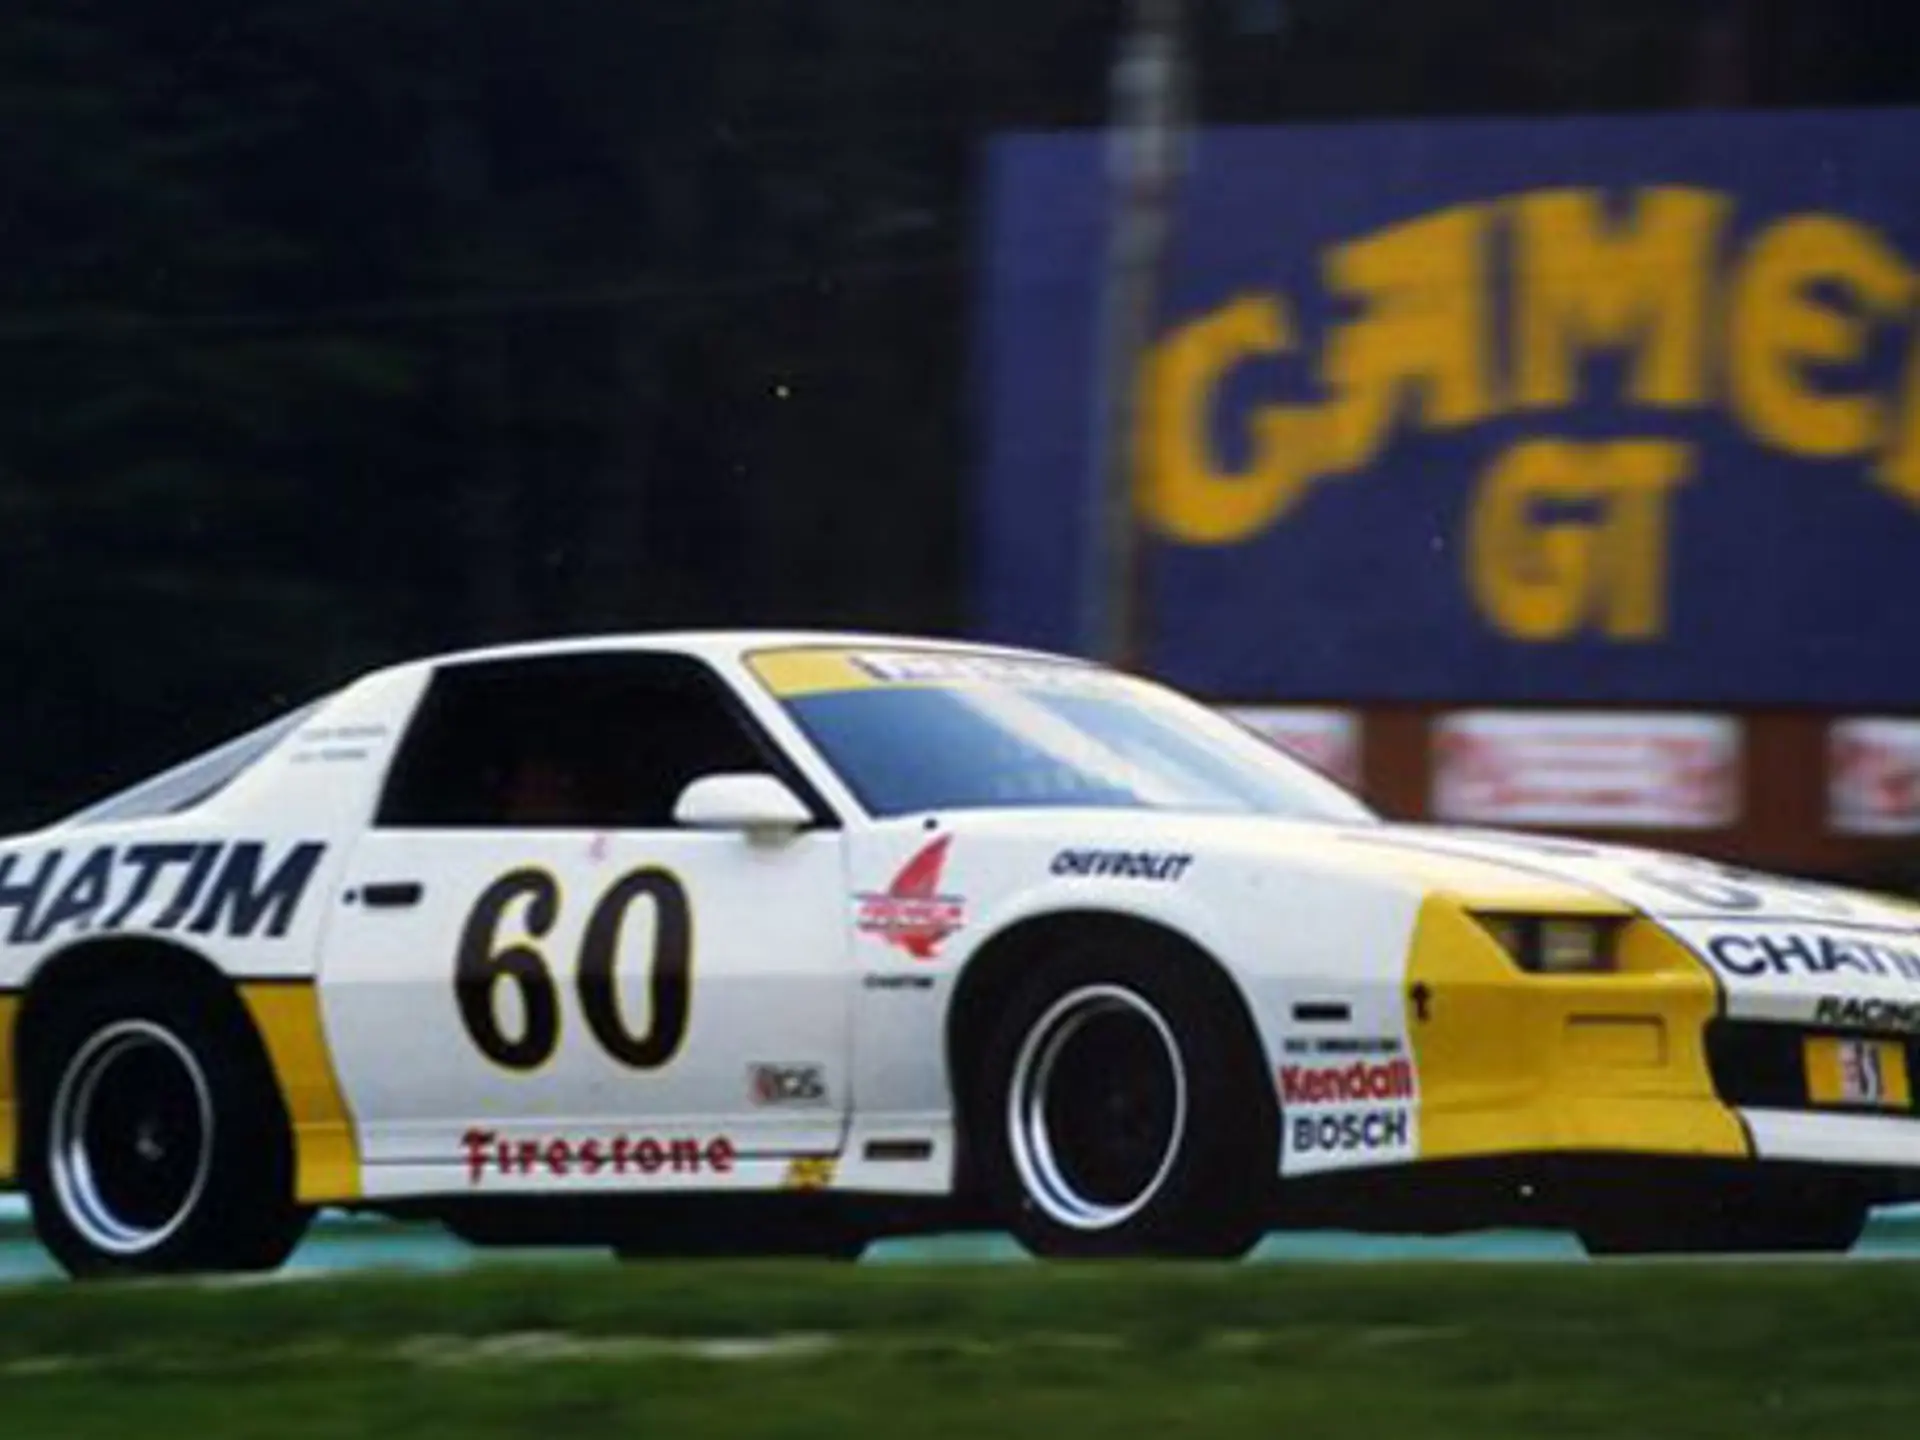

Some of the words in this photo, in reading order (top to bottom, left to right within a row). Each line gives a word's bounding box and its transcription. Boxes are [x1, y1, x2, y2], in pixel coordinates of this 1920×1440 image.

[1137, 185, 1920, 543] CAME
[1465, 436, 1695, 642] GT
[1049, 849, 1193, 881] CHEVROLET
[455, 865, 692, 1072] 60
[1281, 1060, 1413, 1104] Kendall
[461, 1128, 735, 1184] Firestone
[1293, 1109, 1408, 1153] BOSCH
